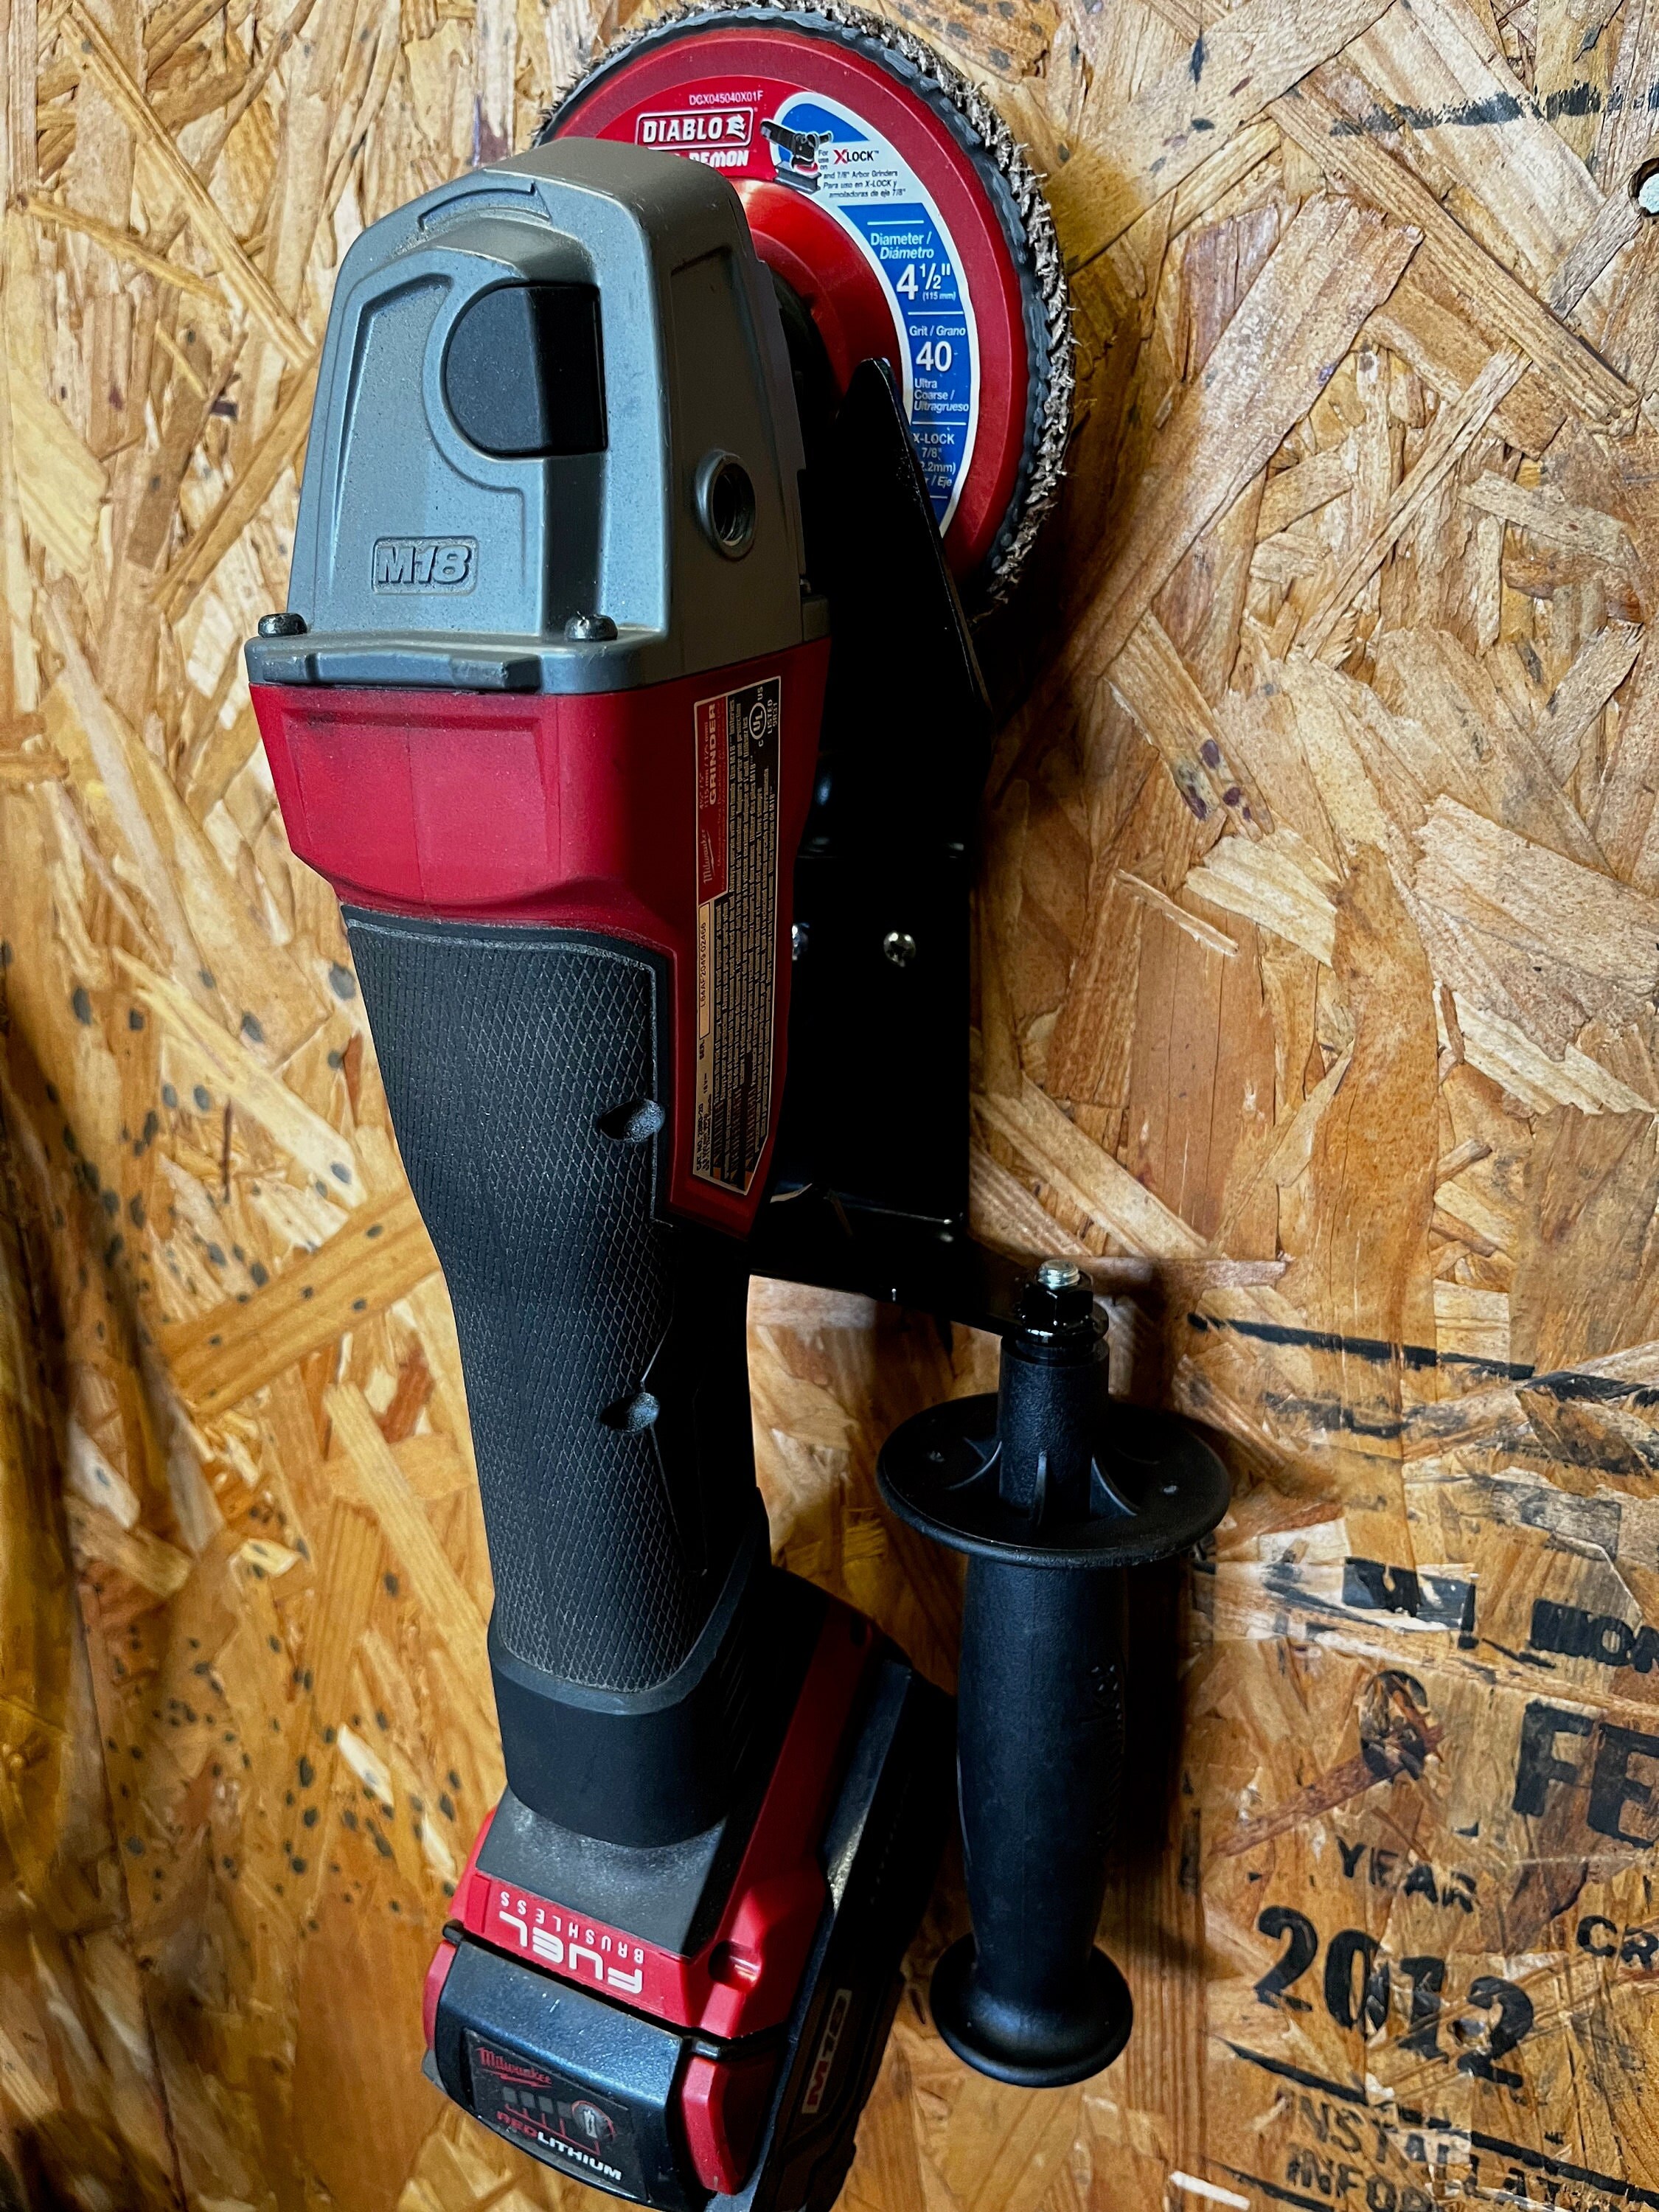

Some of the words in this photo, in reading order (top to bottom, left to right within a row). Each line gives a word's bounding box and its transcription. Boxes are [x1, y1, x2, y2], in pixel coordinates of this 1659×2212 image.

[643, 116, 723, 144] DIABLO
[865, 179, 891, 187] X-LOCK
[871, 232, 924, 246] Diameter
[880, 246, 934, 260] Diámetro
[909, 325, 928, 336] Grit
[936, 325, 966, 336] Grano
[916, 341, 952, 372] 40
[914, 378, 937, 389] Ultra
[914, 389, 948, 400] Coarse
[914, 400, 969, 413] Ultragrueso
[913, 433, 955, 445] X-LOCK
[937, 476, 953, 489] Eje
[376, 545, 473, 585] M18
[757, 686, 764, 700] US
[1338, 1836, 1475, 1913] YEAR
[500, 1891, 644, 1964] BRUSHLESS
[499, 1910, 643, 1994] FUEL
[1253, 1905, 1534, 2088] 2012
[807, 1995, 847, 2106] M18
[476, 2047, 552, 2084] Milwaukee
[496, 2110, 622, 2181] REDLITHIUM
